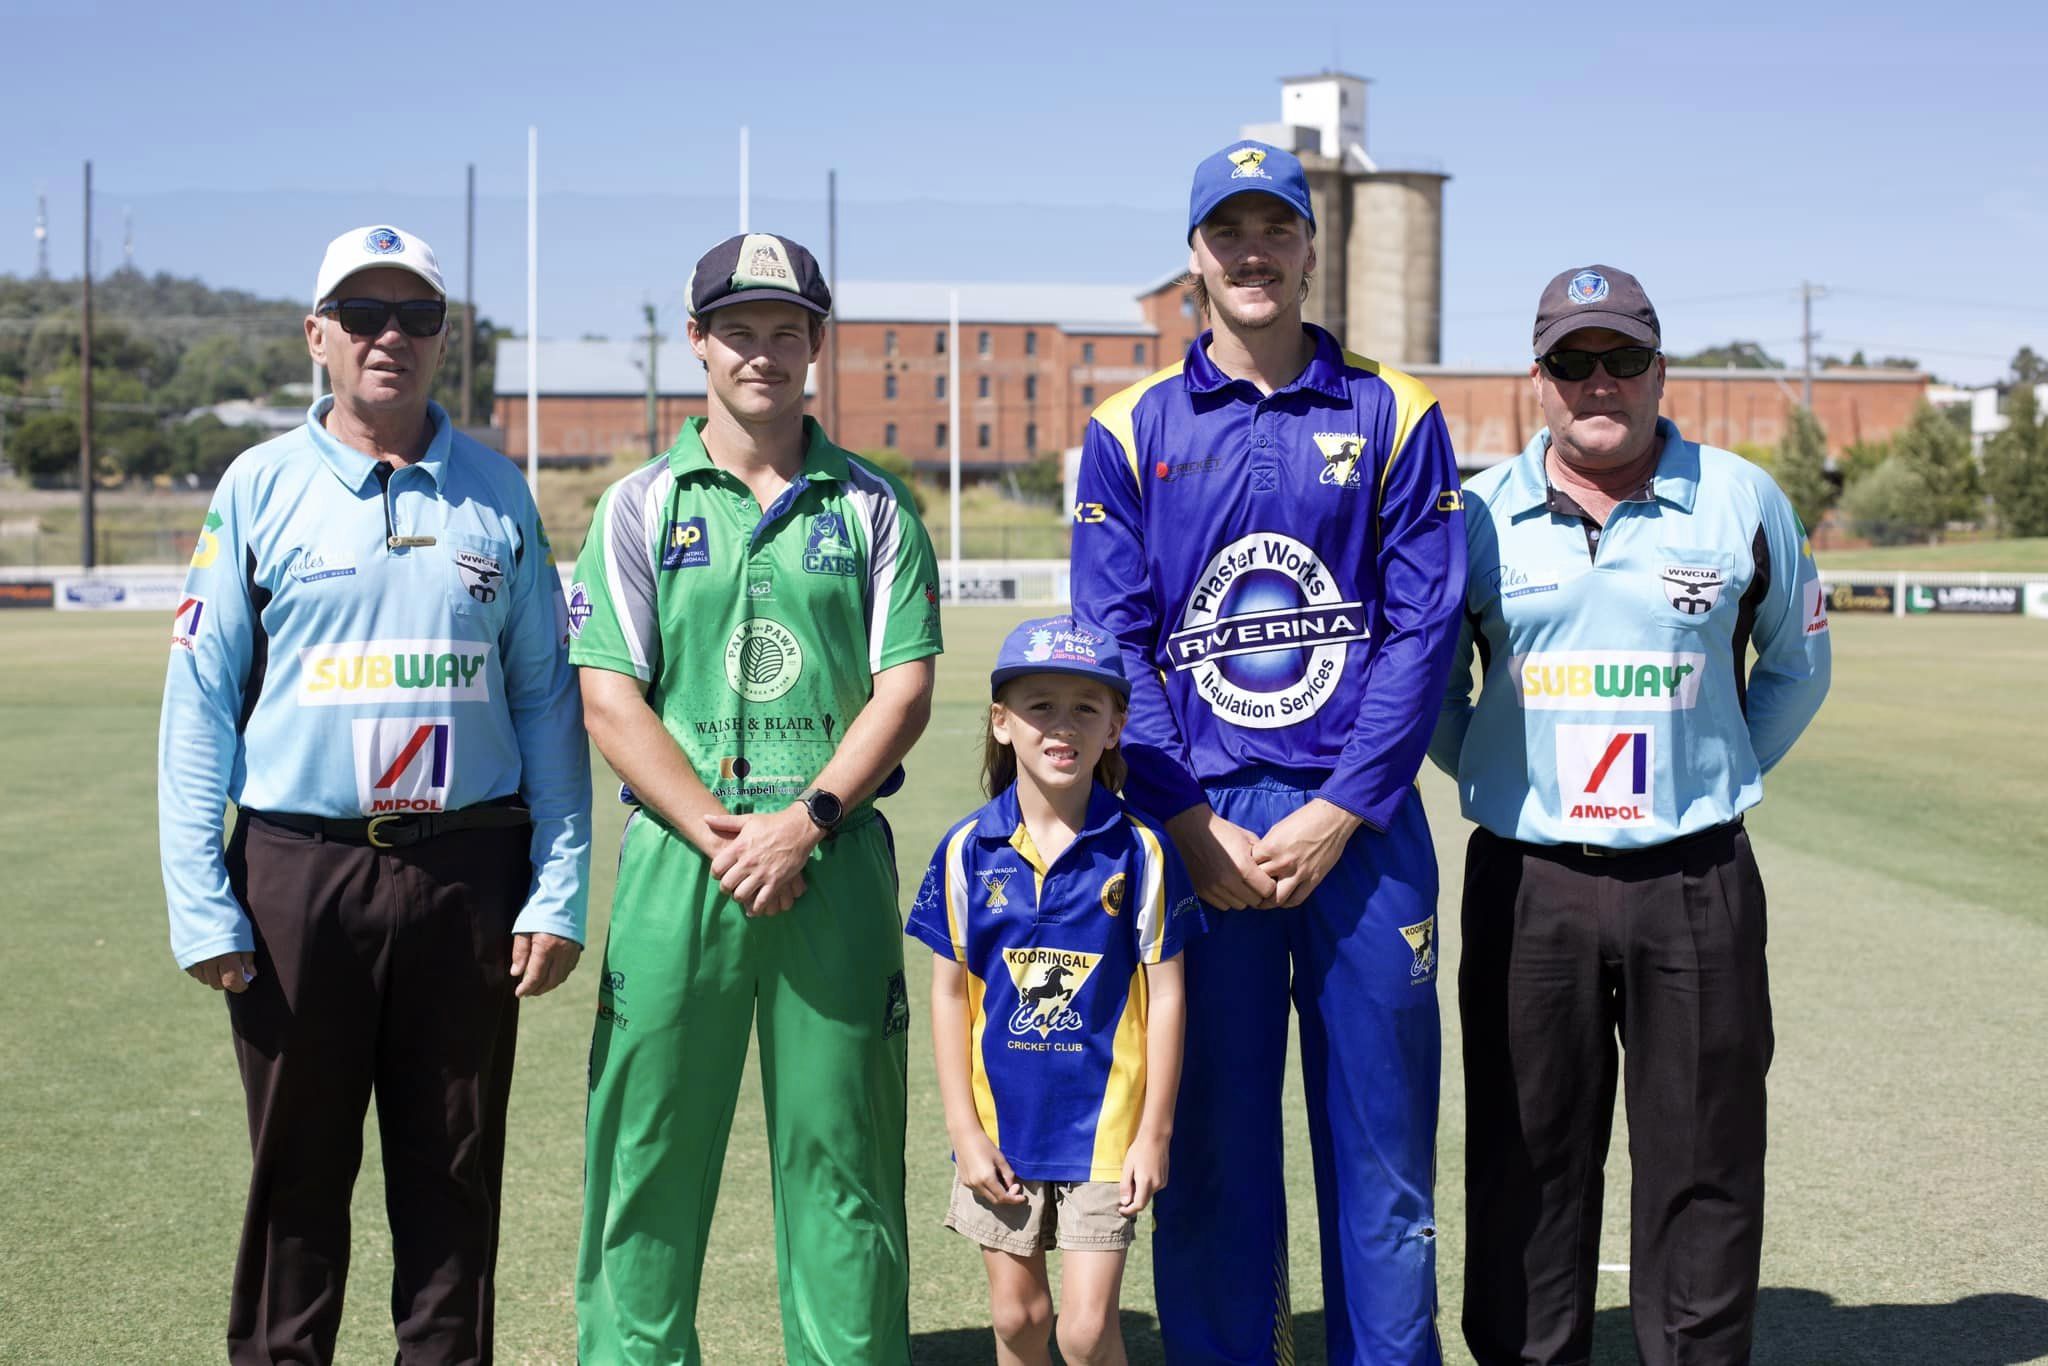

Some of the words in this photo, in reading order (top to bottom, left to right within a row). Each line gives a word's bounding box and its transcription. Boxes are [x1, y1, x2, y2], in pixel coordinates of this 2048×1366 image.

[750, 266, 787, 279] CATS
[1313, 431, 1364, 440] KOORINGL
[1319, 463, 1361, 484] Cts
[804, 554, 858, 575] CATS
[1668, 568, 1718, 579] WWCUA
[1193, 543, 1258, 614] Plaster
[1264, 541, 1326, 598] Works
[728, 624, 753, 659] PALM
[763, 624, 797, 657] PAWN
[1179, 614, 1356, 659] RIVERINA
[1065, 641, 1097, 658] Bob
[306, 653, 485, 692] SUBWAY
[1523, 663, 1695, 698] SUBWAY
[1280, 658, 1335, 717] Services
[695, 716, 744, 735] WALSH
[747, 717, 760, 730] &
[764, 717, 815, 731] BLAIR
[370, 799, 443, 813] MPOL
[1569, 804, 1646, 820] AMPOL
[1009, 950, 1091, 969] KOORINGAL
[1008, 999, 1084, 1036] Colts
[1007, 1039, 1052, 1052] CRICKET
[1054, 1042, 1083, 1053] CLUB
